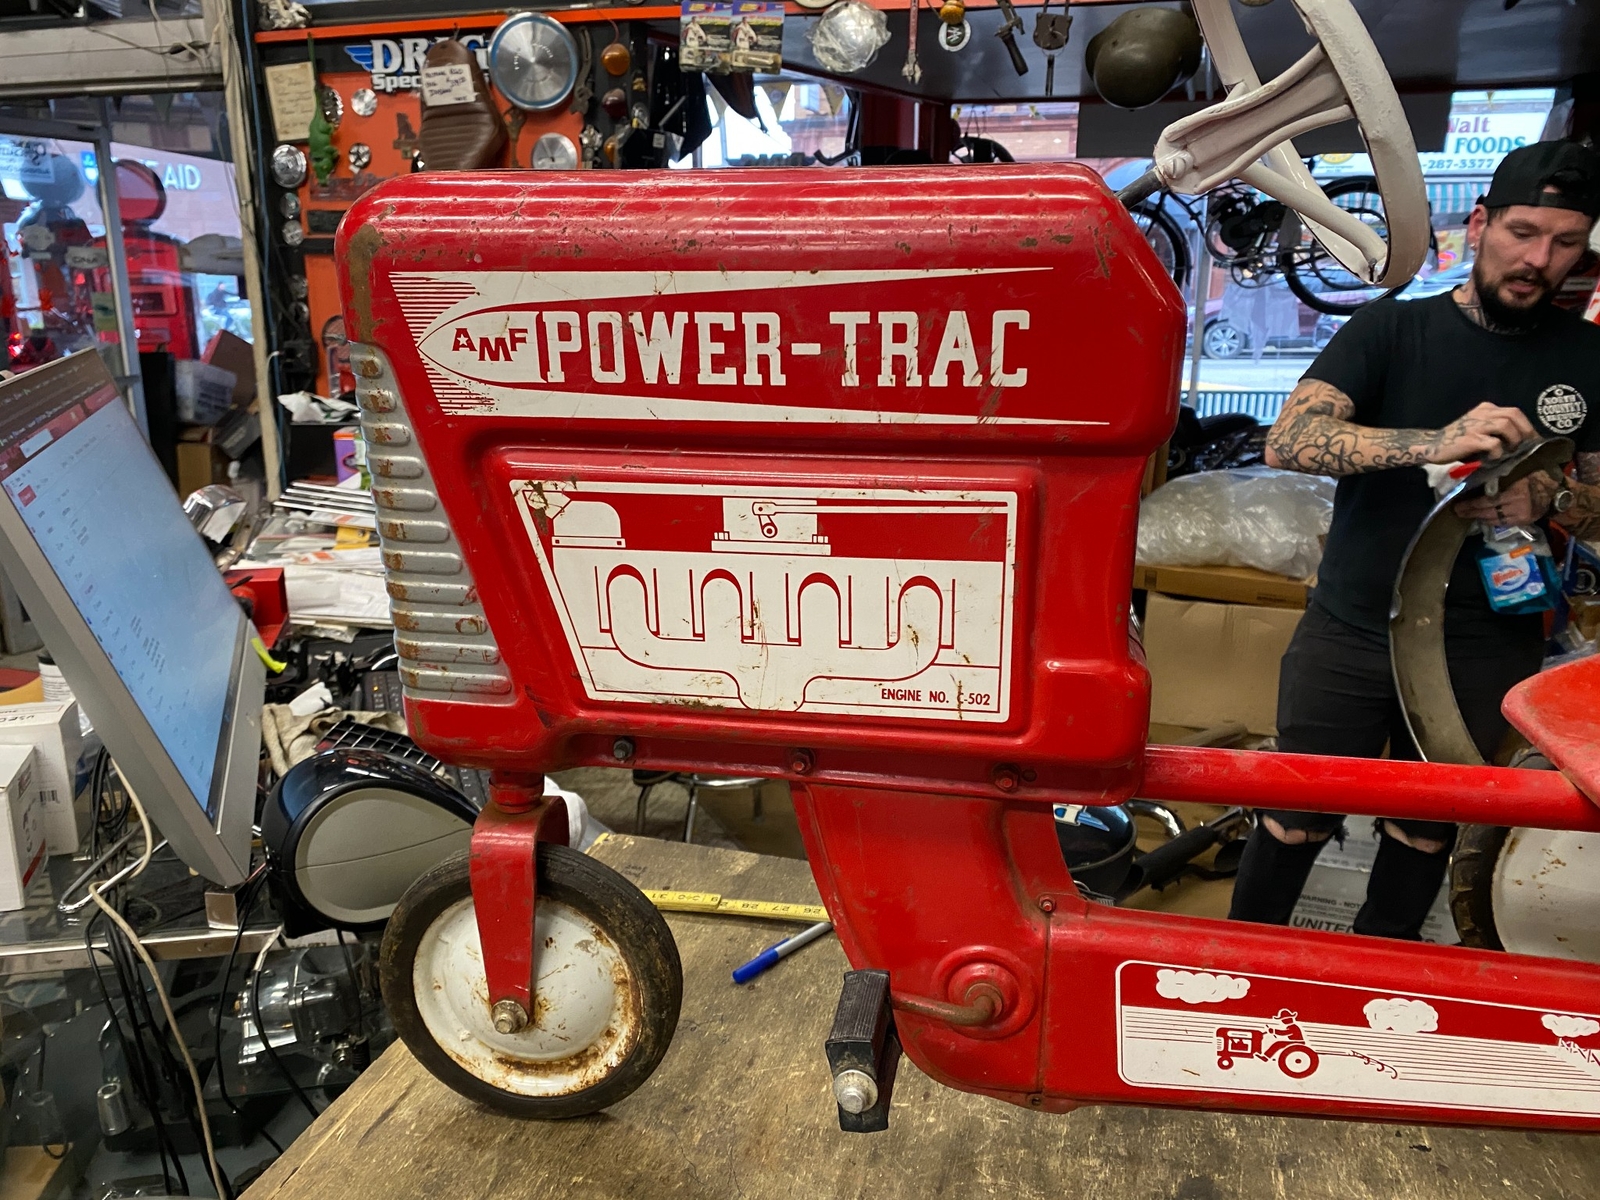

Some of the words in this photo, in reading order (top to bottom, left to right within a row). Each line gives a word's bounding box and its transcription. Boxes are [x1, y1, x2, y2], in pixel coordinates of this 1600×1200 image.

[371, 35, 491, 73] DRG
[1454, 136, 1526, 154] FOODS
[163, 163, 201, 190] AID
[452, 328, 528, 361] AMF
[542, 310, 1030, 387] POWER-TRAC
[881, 688, 922, 702] ENGINE
[929, 691, 949, 703] NO.
[1293, 916, 1354, 934] UNITE
